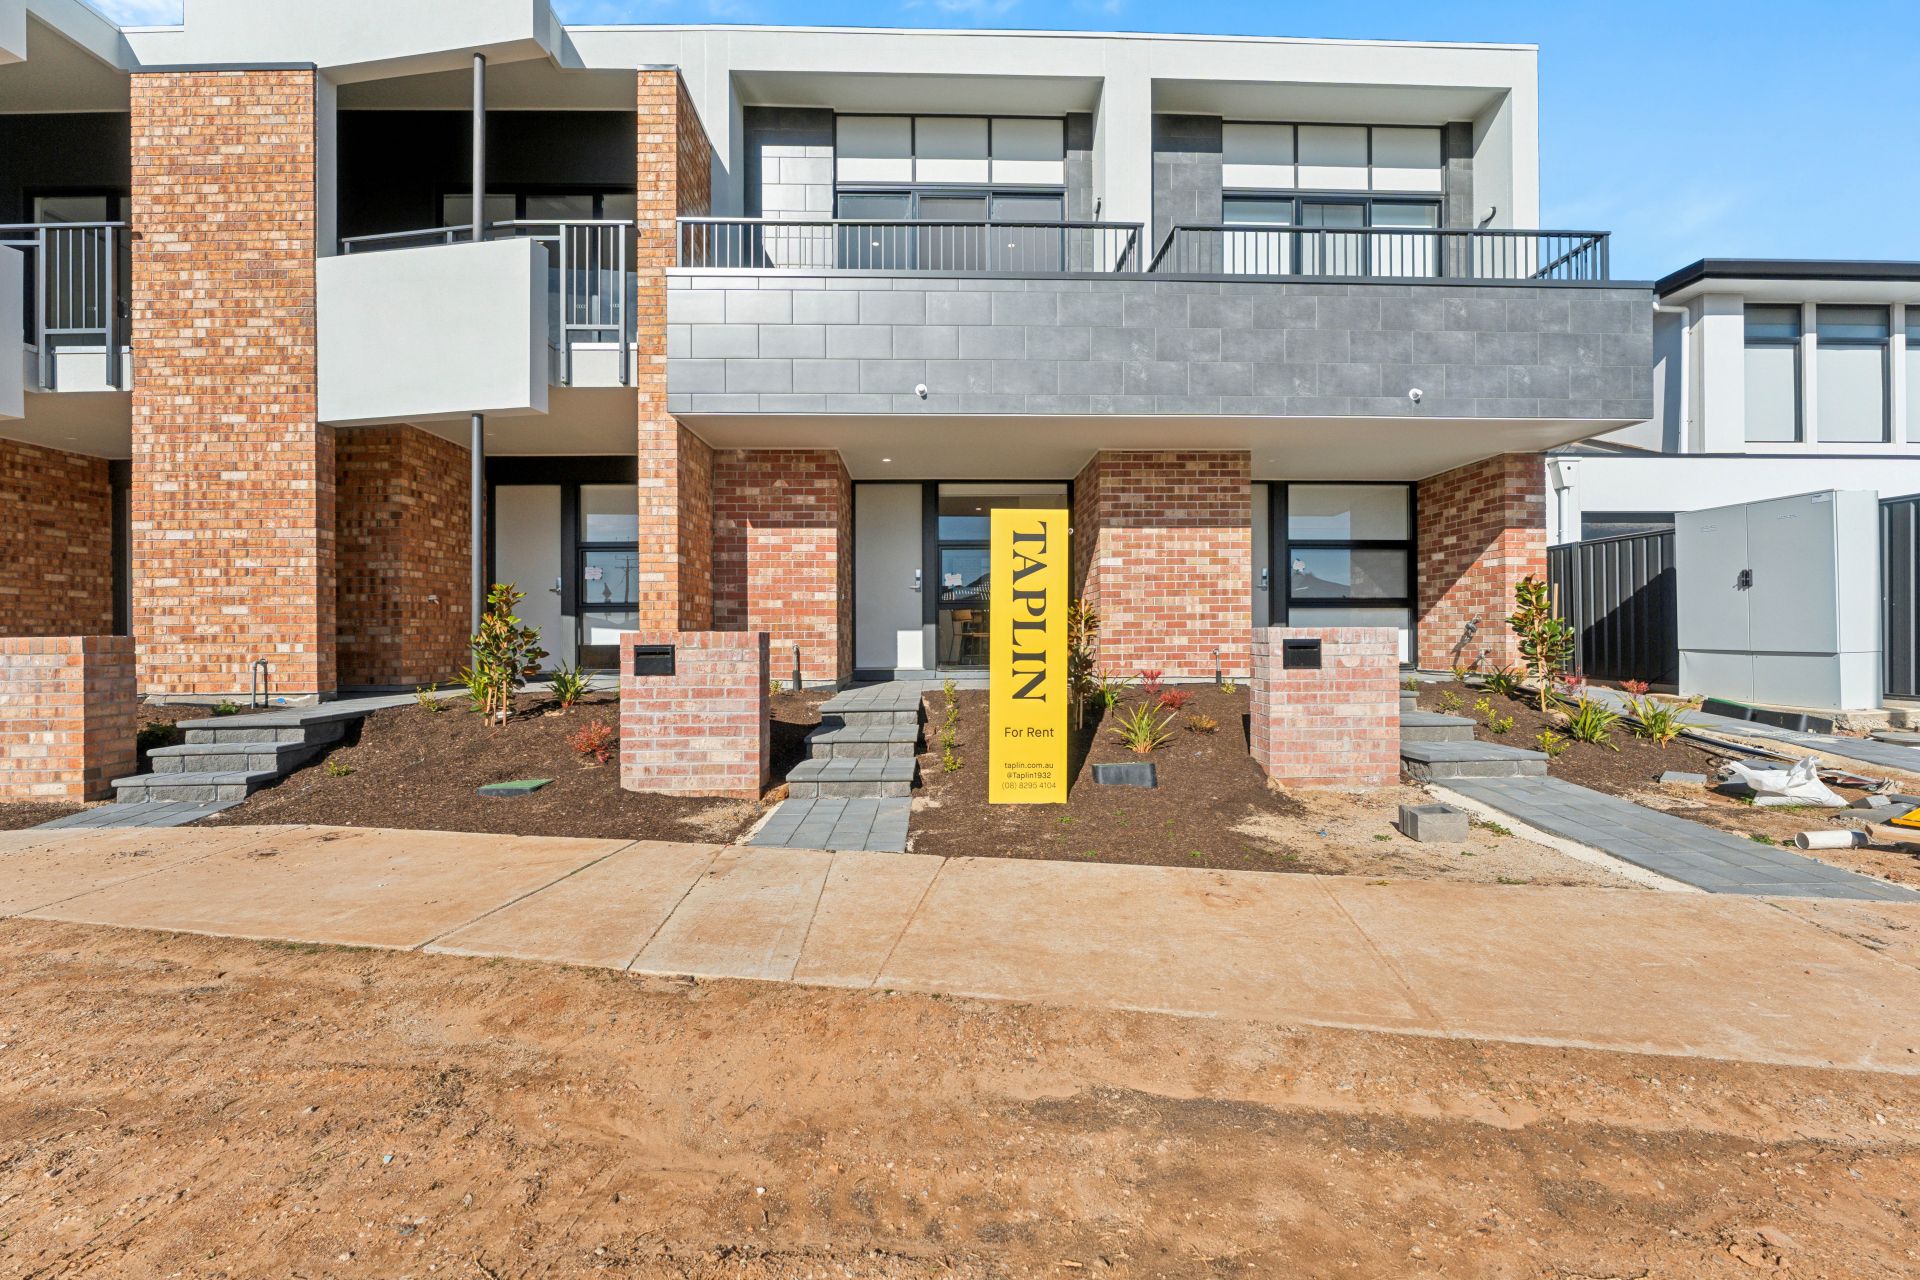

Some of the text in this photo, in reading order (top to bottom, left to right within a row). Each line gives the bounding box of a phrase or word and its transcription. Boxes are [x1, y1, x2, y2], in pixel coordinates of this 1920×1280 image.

[1012, 521, 1047, 702] TAPLIN
[1004, 727, 1054, 738] For Rent
[1004, 762, 1054, 770] taplin.com.au
[1007, 772, 1052, 780] @Taplin1932
[1001, 782, 1017, 790] (08)
